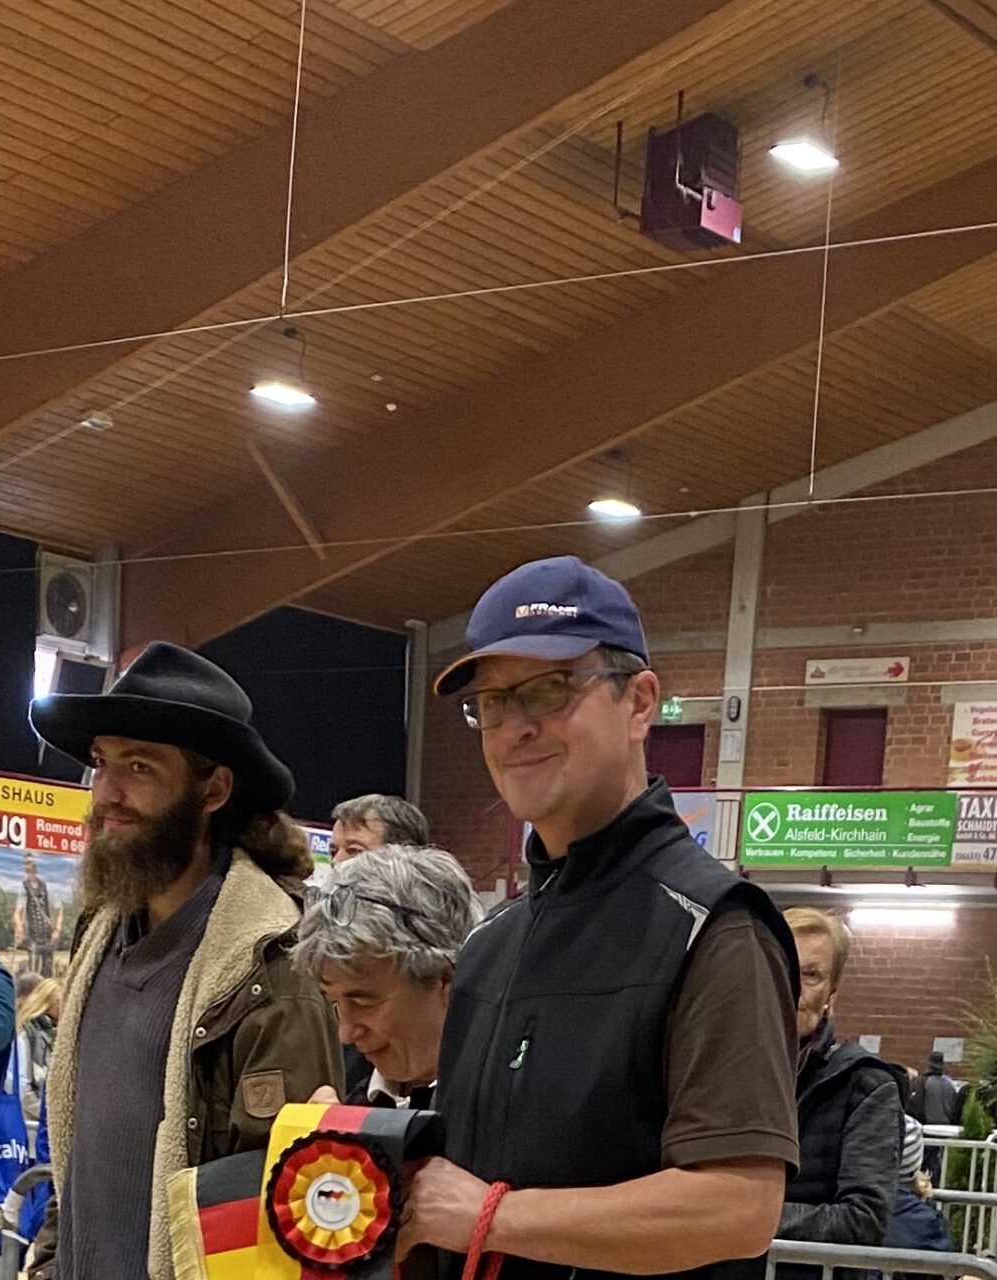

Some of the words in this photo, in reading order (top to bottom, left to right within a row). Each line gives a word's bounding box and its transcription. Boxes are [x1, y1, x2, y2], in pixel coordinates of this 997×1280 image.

[786, 803, 887, 821] Raiffeisen
[910, 803, 935, 814] Agrar
[960, 797, 997, 818] TAXI
[36, 818, 83, 837] Romrod
[908, 819, 951, 828] Baustoffe
[957, 819, 997, 832] SCHMIDT
[784, 827, 887, 842] Alsfeld-Kirchhain
[907, 834, 940, 843] Energie
[36, 835, 57, 849] Tel.
[745, 847, 784, 857] Vertrauen
[790, 848, 837, 859] Kompetenz
[844, 848, 886, 858] Sicherheit
